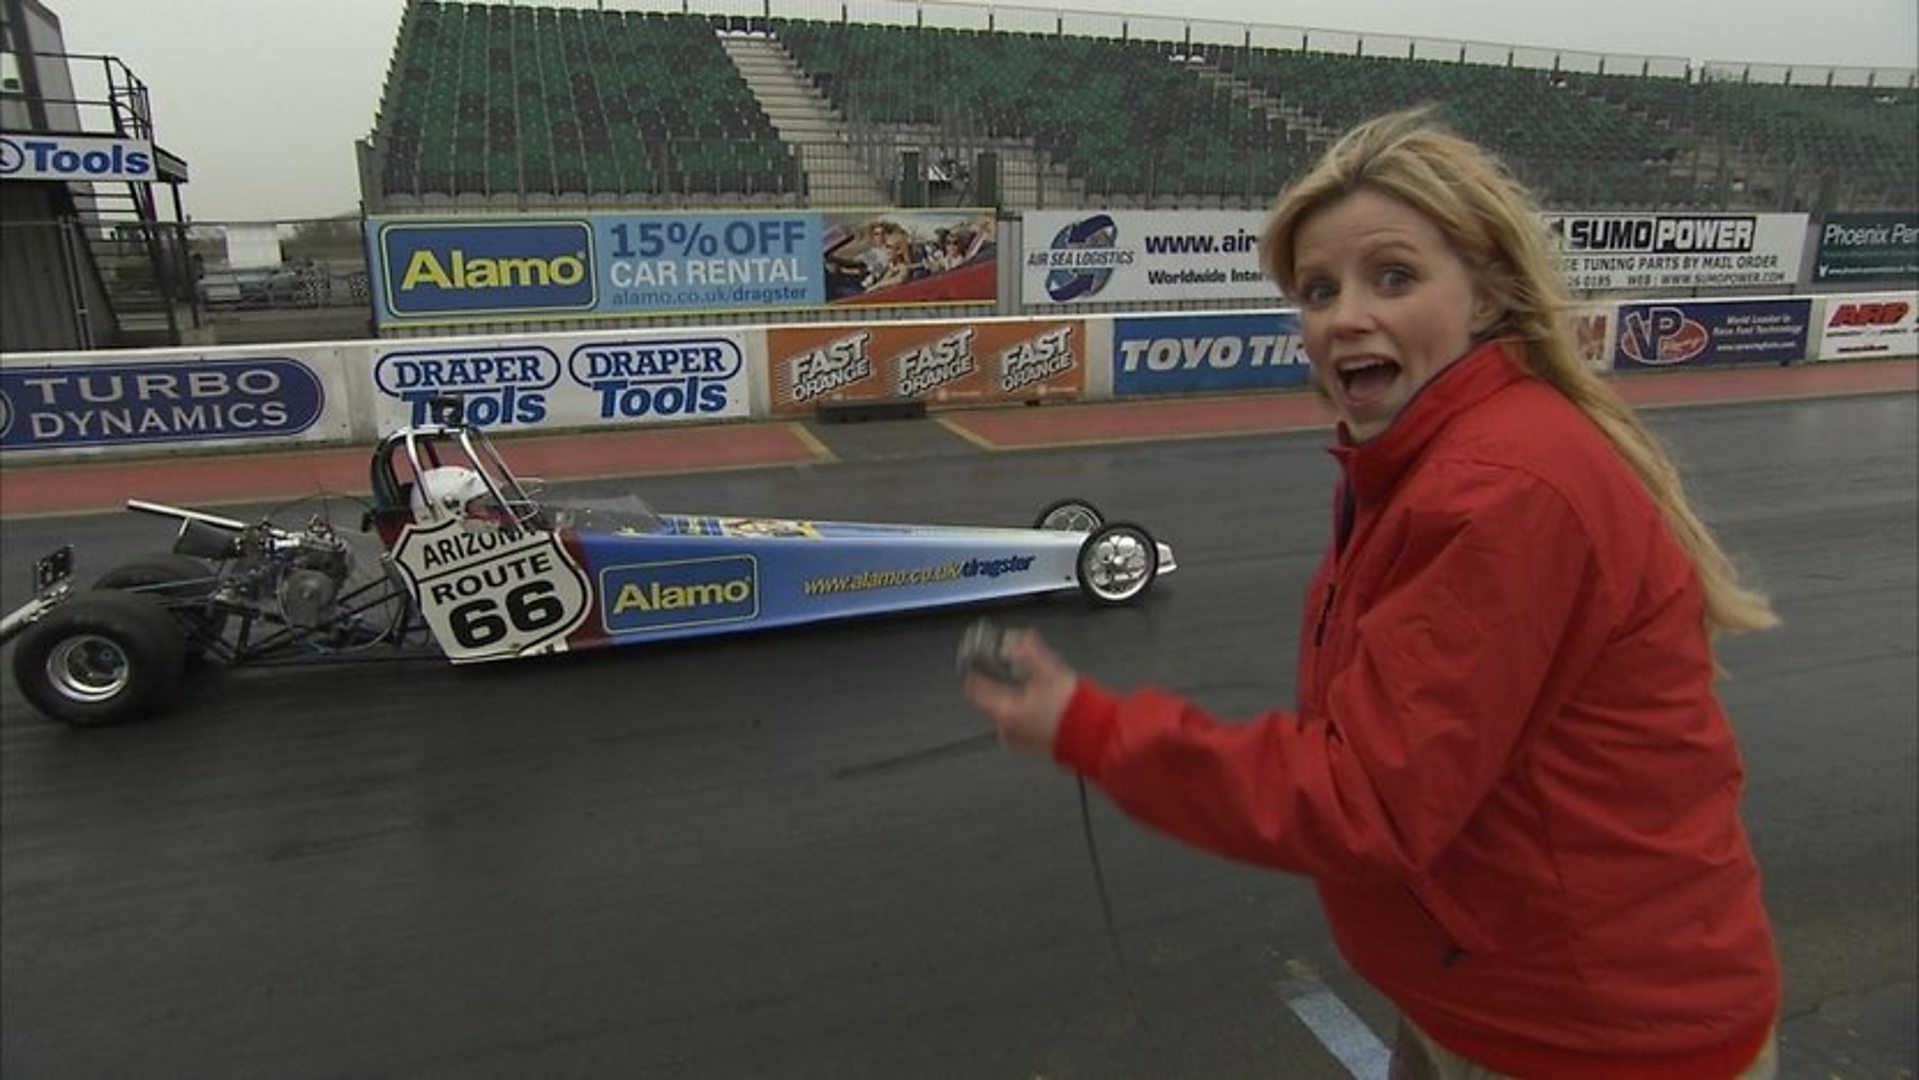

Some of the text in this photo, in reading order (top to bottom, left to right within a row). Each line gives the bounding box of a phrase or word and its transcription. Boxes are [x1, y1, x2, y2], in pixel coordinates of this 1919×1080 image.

[25, 142, 150, 175] Tools
[611, 221, 805, 258] 15% OFF
[1145, 228, 1257, 254] www.air
[1823, 222, 1889, 245] Phoenix
[402, 250, 584, 290] Alamo
[610, 258, 808, 287] CAR RENTAL
[1028, 250, 1135, 266] AIR SEA LOGISTICS
[1148, 268, 1226, 284] Worldwide
[1584, 257, 1635, 271] TUNING
[1638, 255, 1680, 270] PARTS
[1682, 256, 1698, 269] BY
[1702, 255, 1733, 269] MAIL
[1736, 254, 1778, 268] ORDER
[612, 285, 808, 306] alamo.co.uk/dragster
[586, 346, 728, 379] DRAPER
[790, 330, 869, 384] FAST
[899, 329, 974, 378] FAST
[1001, 327, 1072, 374] FAST
[1120, 334, 1310, 372] TOYO TIR
[24, 369, 281, 405] TURBO
[393, 355, 544, 388] DRAPER
[792, 361, 871, 401] ORANGE
[900, 357, 973, 396] ORANGE
[1002, 354, 1072, 391] ORANGE
[402, 386, 546, 429] Tols
[592, 376, 728, 419] Tools
[30, 401, 288, 440] DYNAMICS
[423, 526, 536, 570] ARIZON
[431, 552, 552, 605] ROUTE
[613, 578, 750, 615] Alamo
[450, 580, 565, 649] 66
